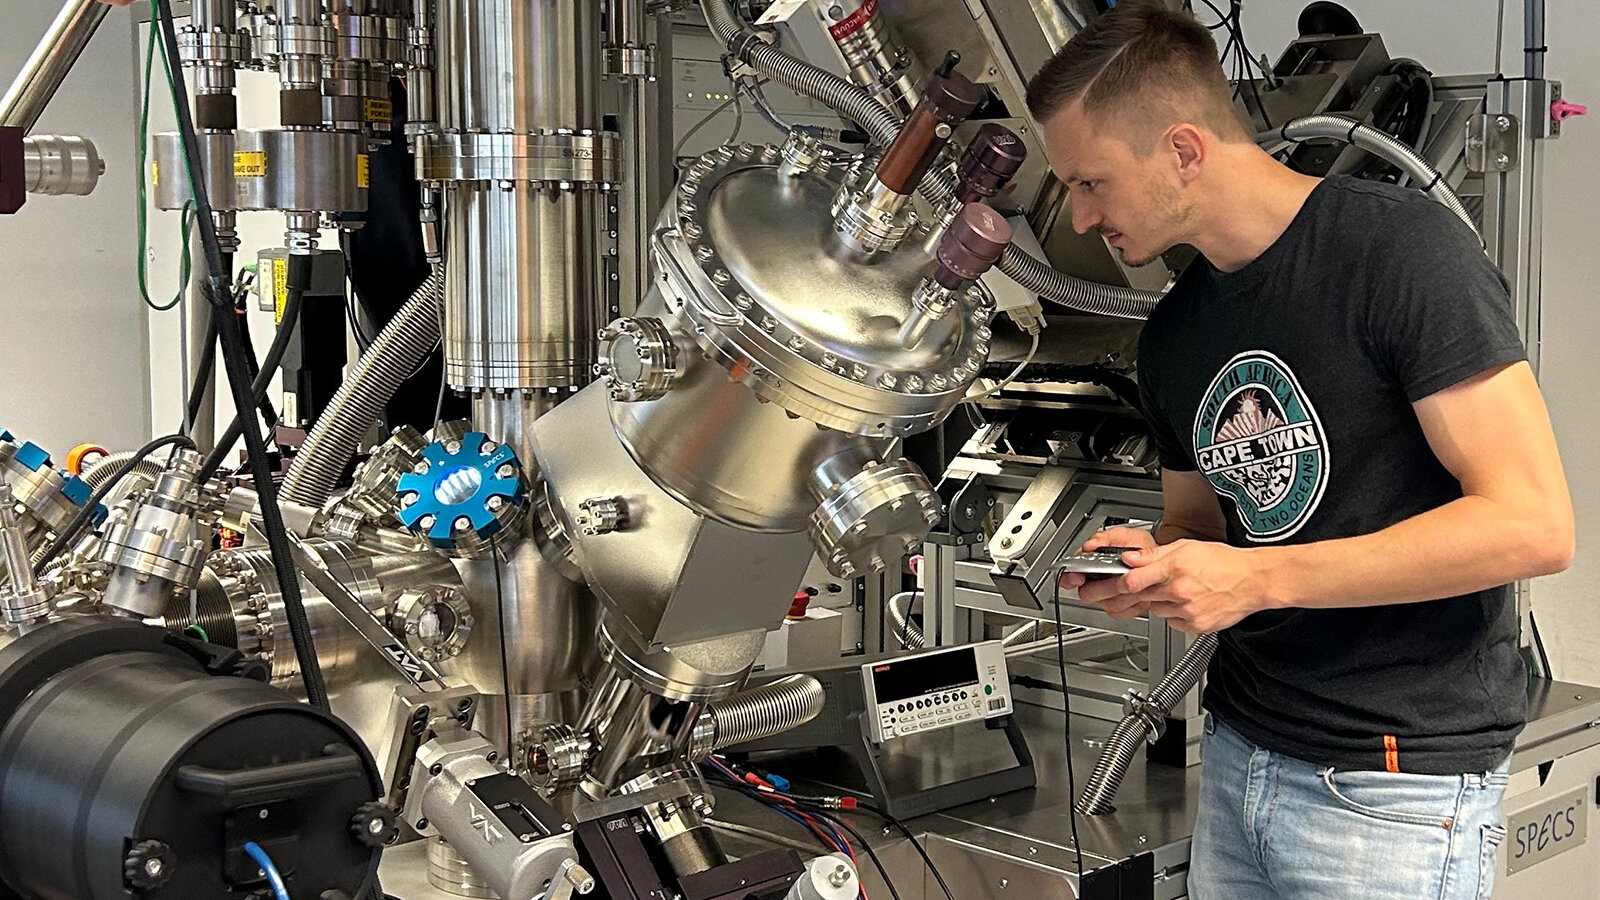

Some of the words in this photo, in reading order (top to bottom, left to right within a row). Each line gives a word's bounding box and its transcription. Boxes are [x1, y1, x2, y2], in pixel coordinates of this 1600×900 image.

[246, 165, 260, 173] OUT
[1202, 369, 1240, 432] SOUTH
[1246, 363, 1293, 408] AFRICA
[1199, 441, 1255, 471] CAPE
[1257, 425, 1318, 457] TOWN
[1215, 474, 1240, 493] THE
[1260, 510, 1290, 529] TWO
[1289, 453, 1315, 512] OCEANS
[384, 646, 424, 682] VAT
[1515, 806, 1575, 859] SPECS
